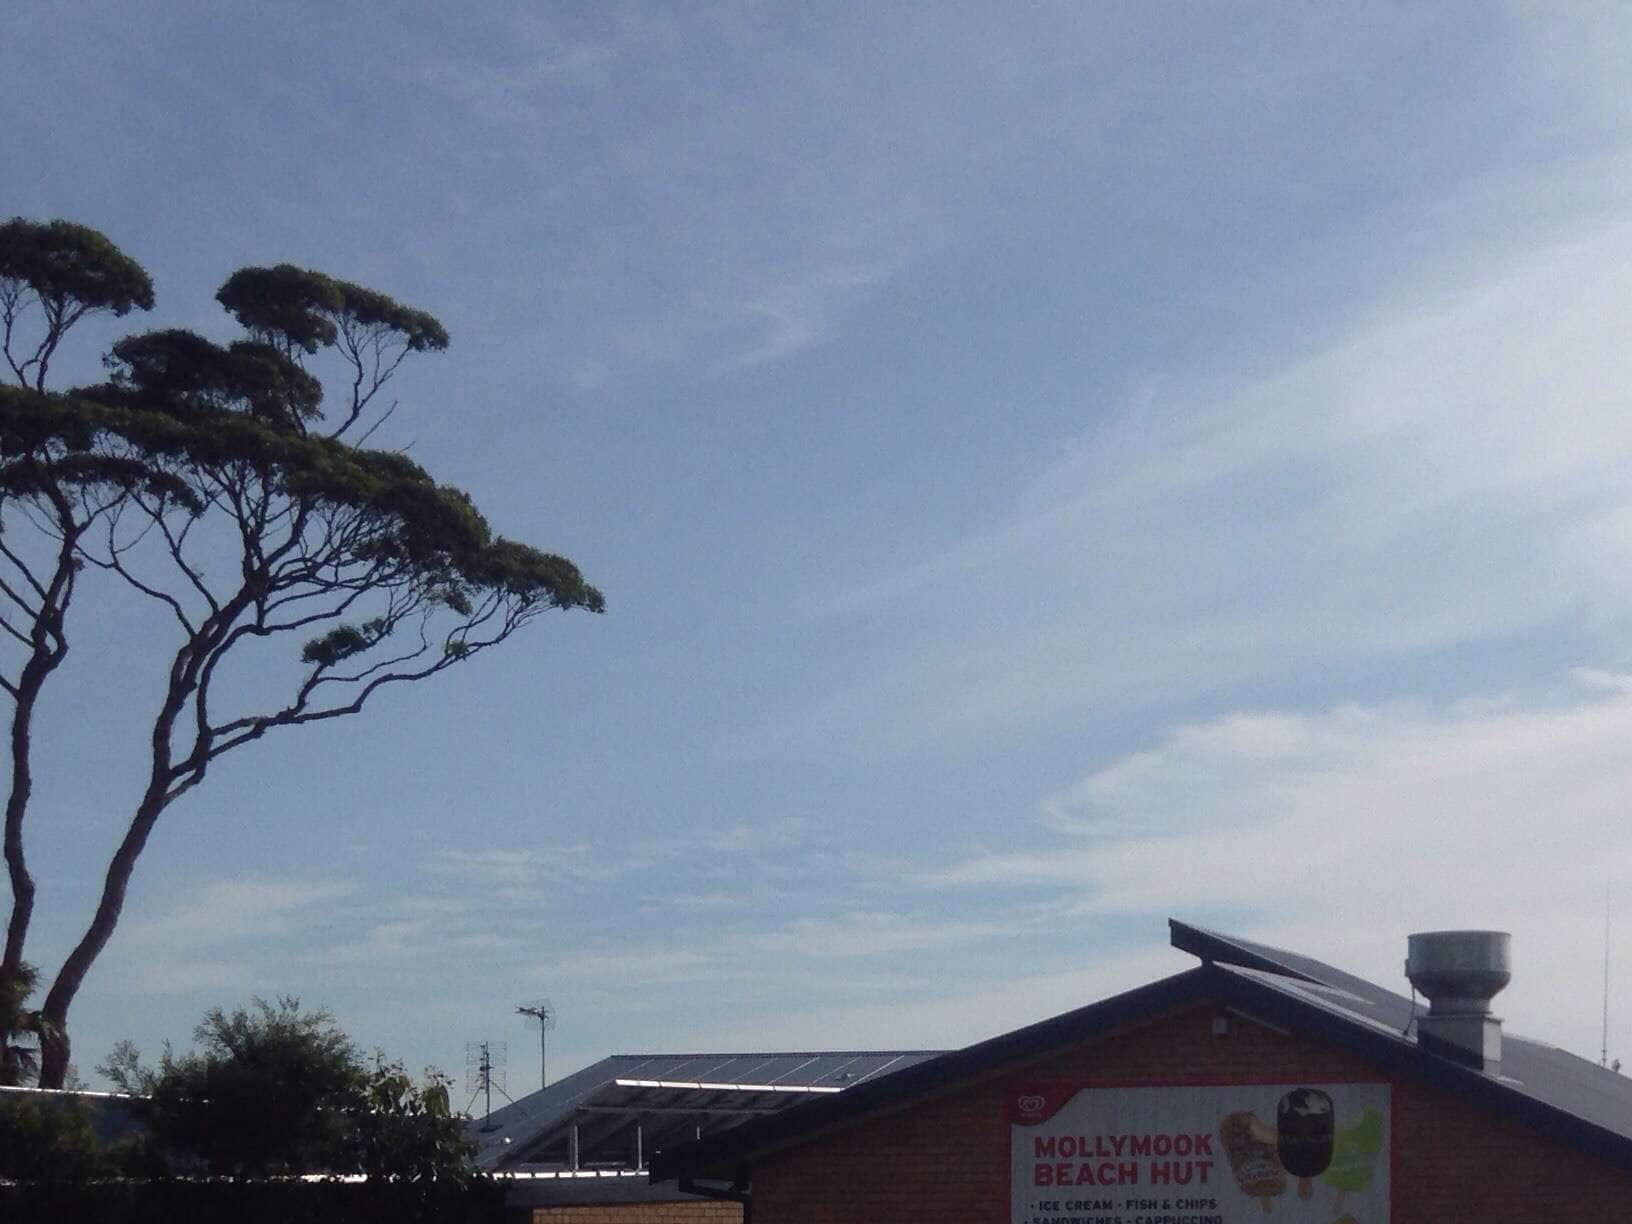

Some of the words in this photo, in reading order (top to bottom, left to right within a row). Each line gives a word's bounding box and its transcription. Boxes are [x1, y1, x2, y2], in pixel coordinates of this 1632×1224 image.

[1034, 1134, 1213, 1158] MOLLYMOOK
[1034, 1162, 1139, 1186] BEACH
[1150, 1161, 1214, 1185] HUT
[1038, 1200, 1061, 1211] ICE
[1065, 1200, 1113, 1211] CREAM
[1125, 1199, 1157, 1210] FISH
[1162, 1199, 1171, 1209] &
[1175, 1198, 1217, 1209] CHIPS
